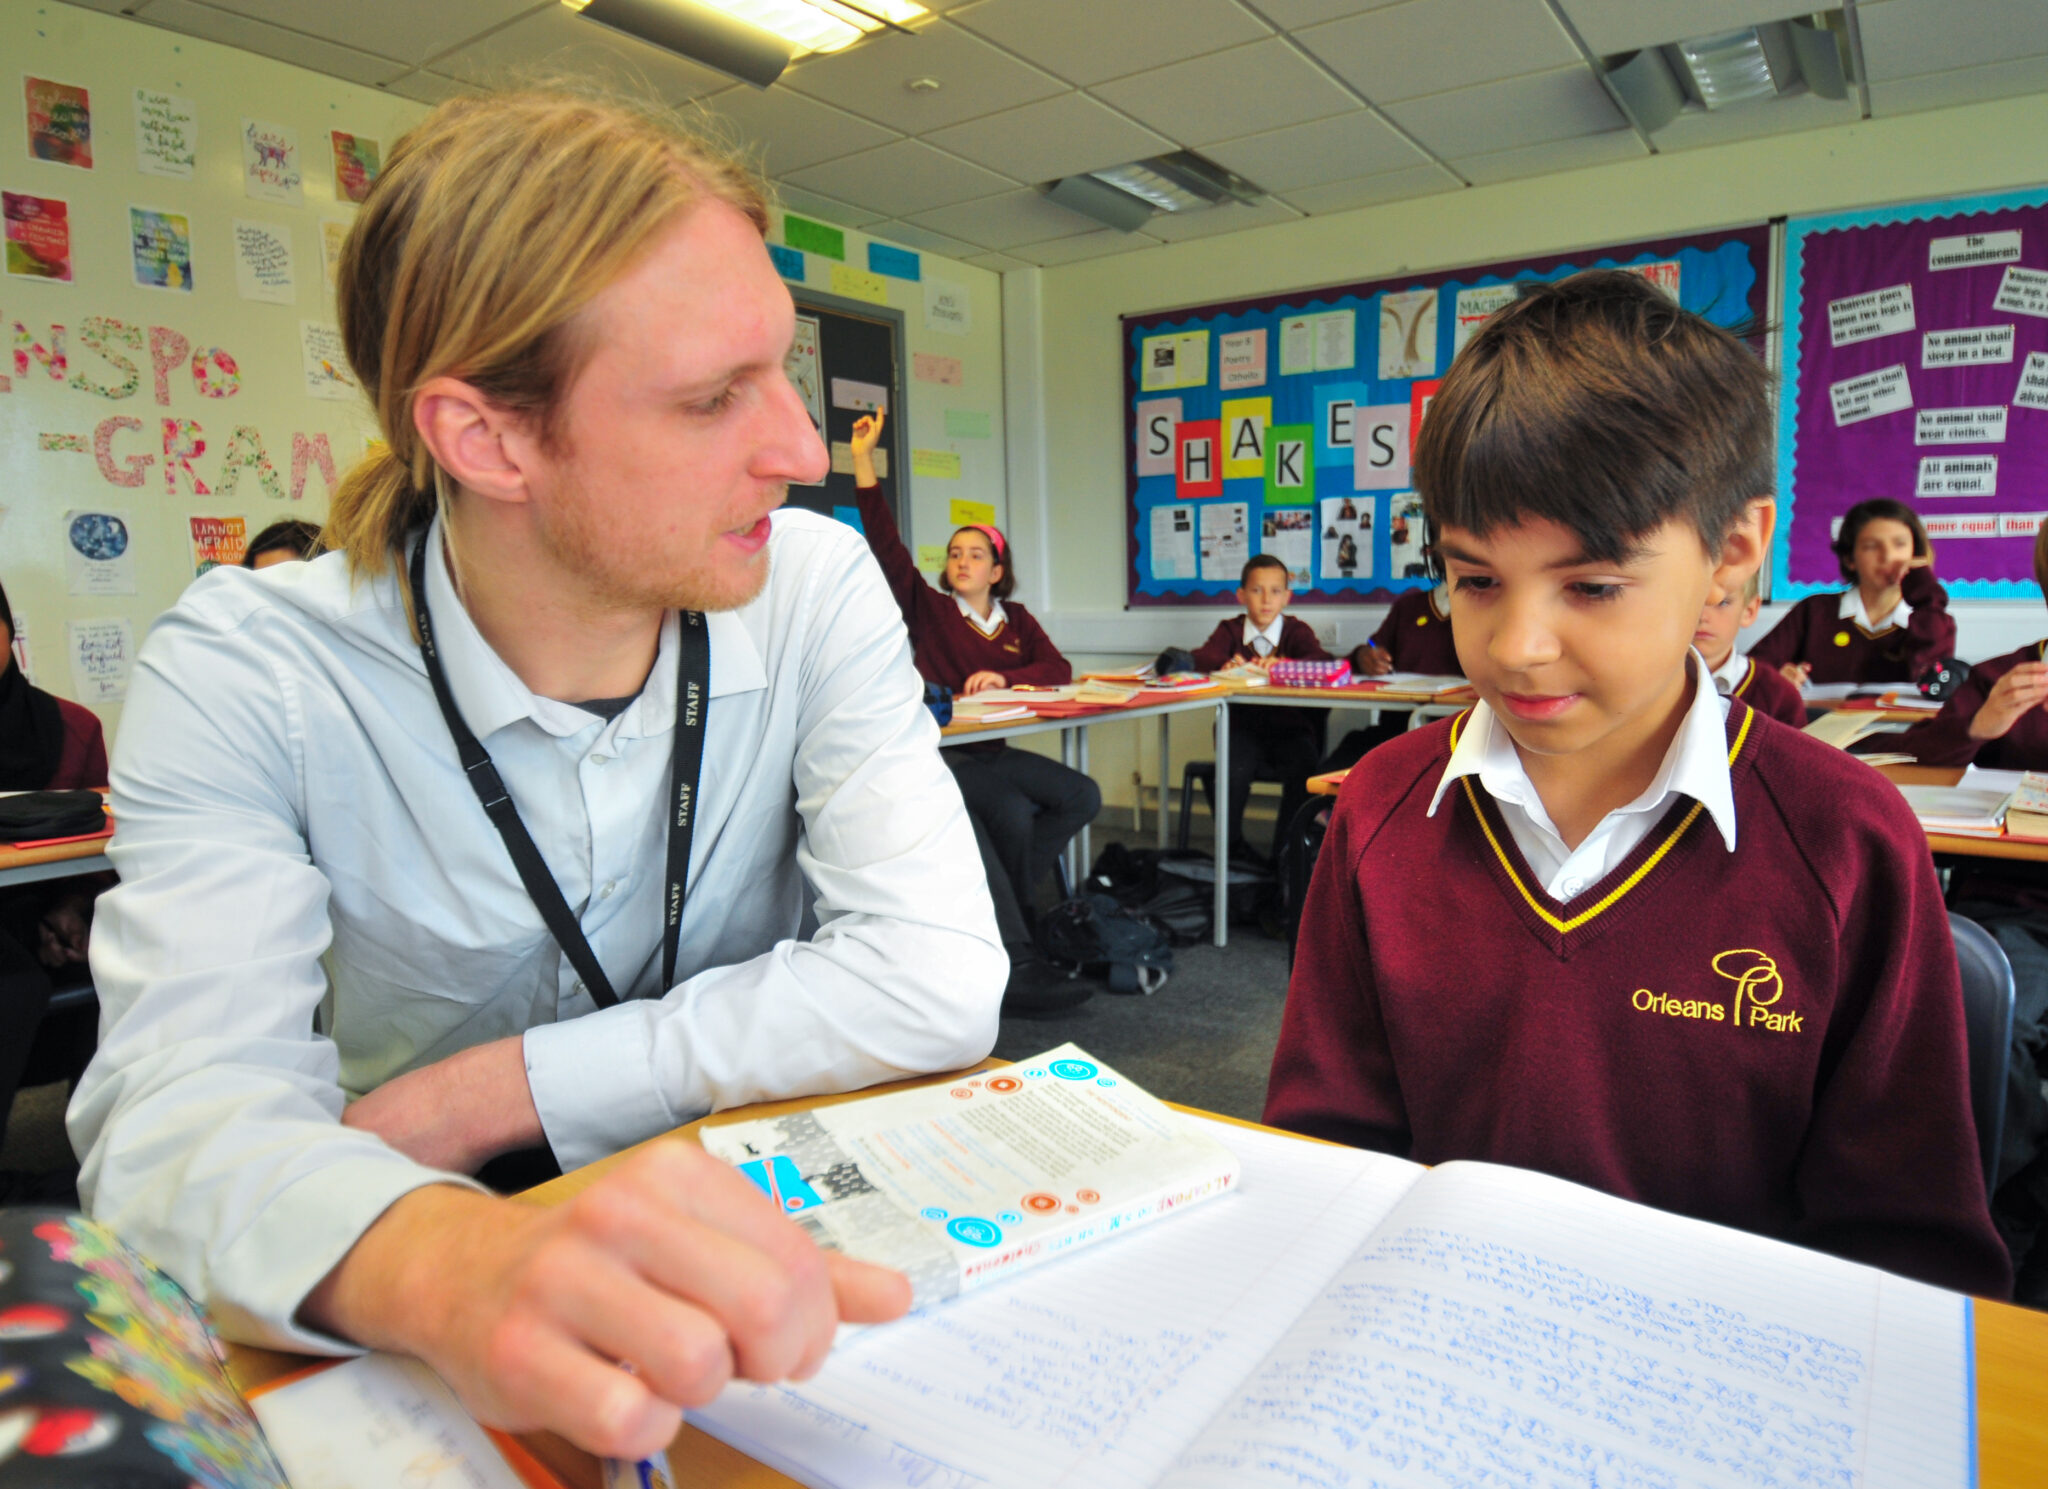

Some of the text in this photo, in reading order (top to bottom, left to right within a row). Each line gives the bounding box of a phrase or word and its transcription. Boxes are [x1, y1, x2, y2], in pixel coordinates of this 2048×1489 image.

[1966, 236, 1984, 247] The
[1931, 248, 2018, 265] commandments
[1928, 331, 2011, 346] No animal shall
[0, 308, 241, 407] NSPO
[1928, 351, 1954, 362] sleep
[1958, 349, 1968, 359] in
[1848, 376, 1879, 392] animal
[1920, 410, 2003, 424] No animal shall
[1920, 430, 1944, 439] wear
[1925, 462, 1992, 473] All animals
[1923, 481, 1943, 490] are
[219, 523, 242, 535] NOT
[1927, 522, 1957, 531] more
[1962, 519, 1997, 532] equal
[2006, 519, 2034, 531] than
[199, 536, 245, 551] AFRAID
[685, 681, 699, 726] STAFF
[677, 783, 691, 827] STAFF
[669, 882, 681, 926] STAFF
[1632, 988, 1804, 1033] Orleans Park
